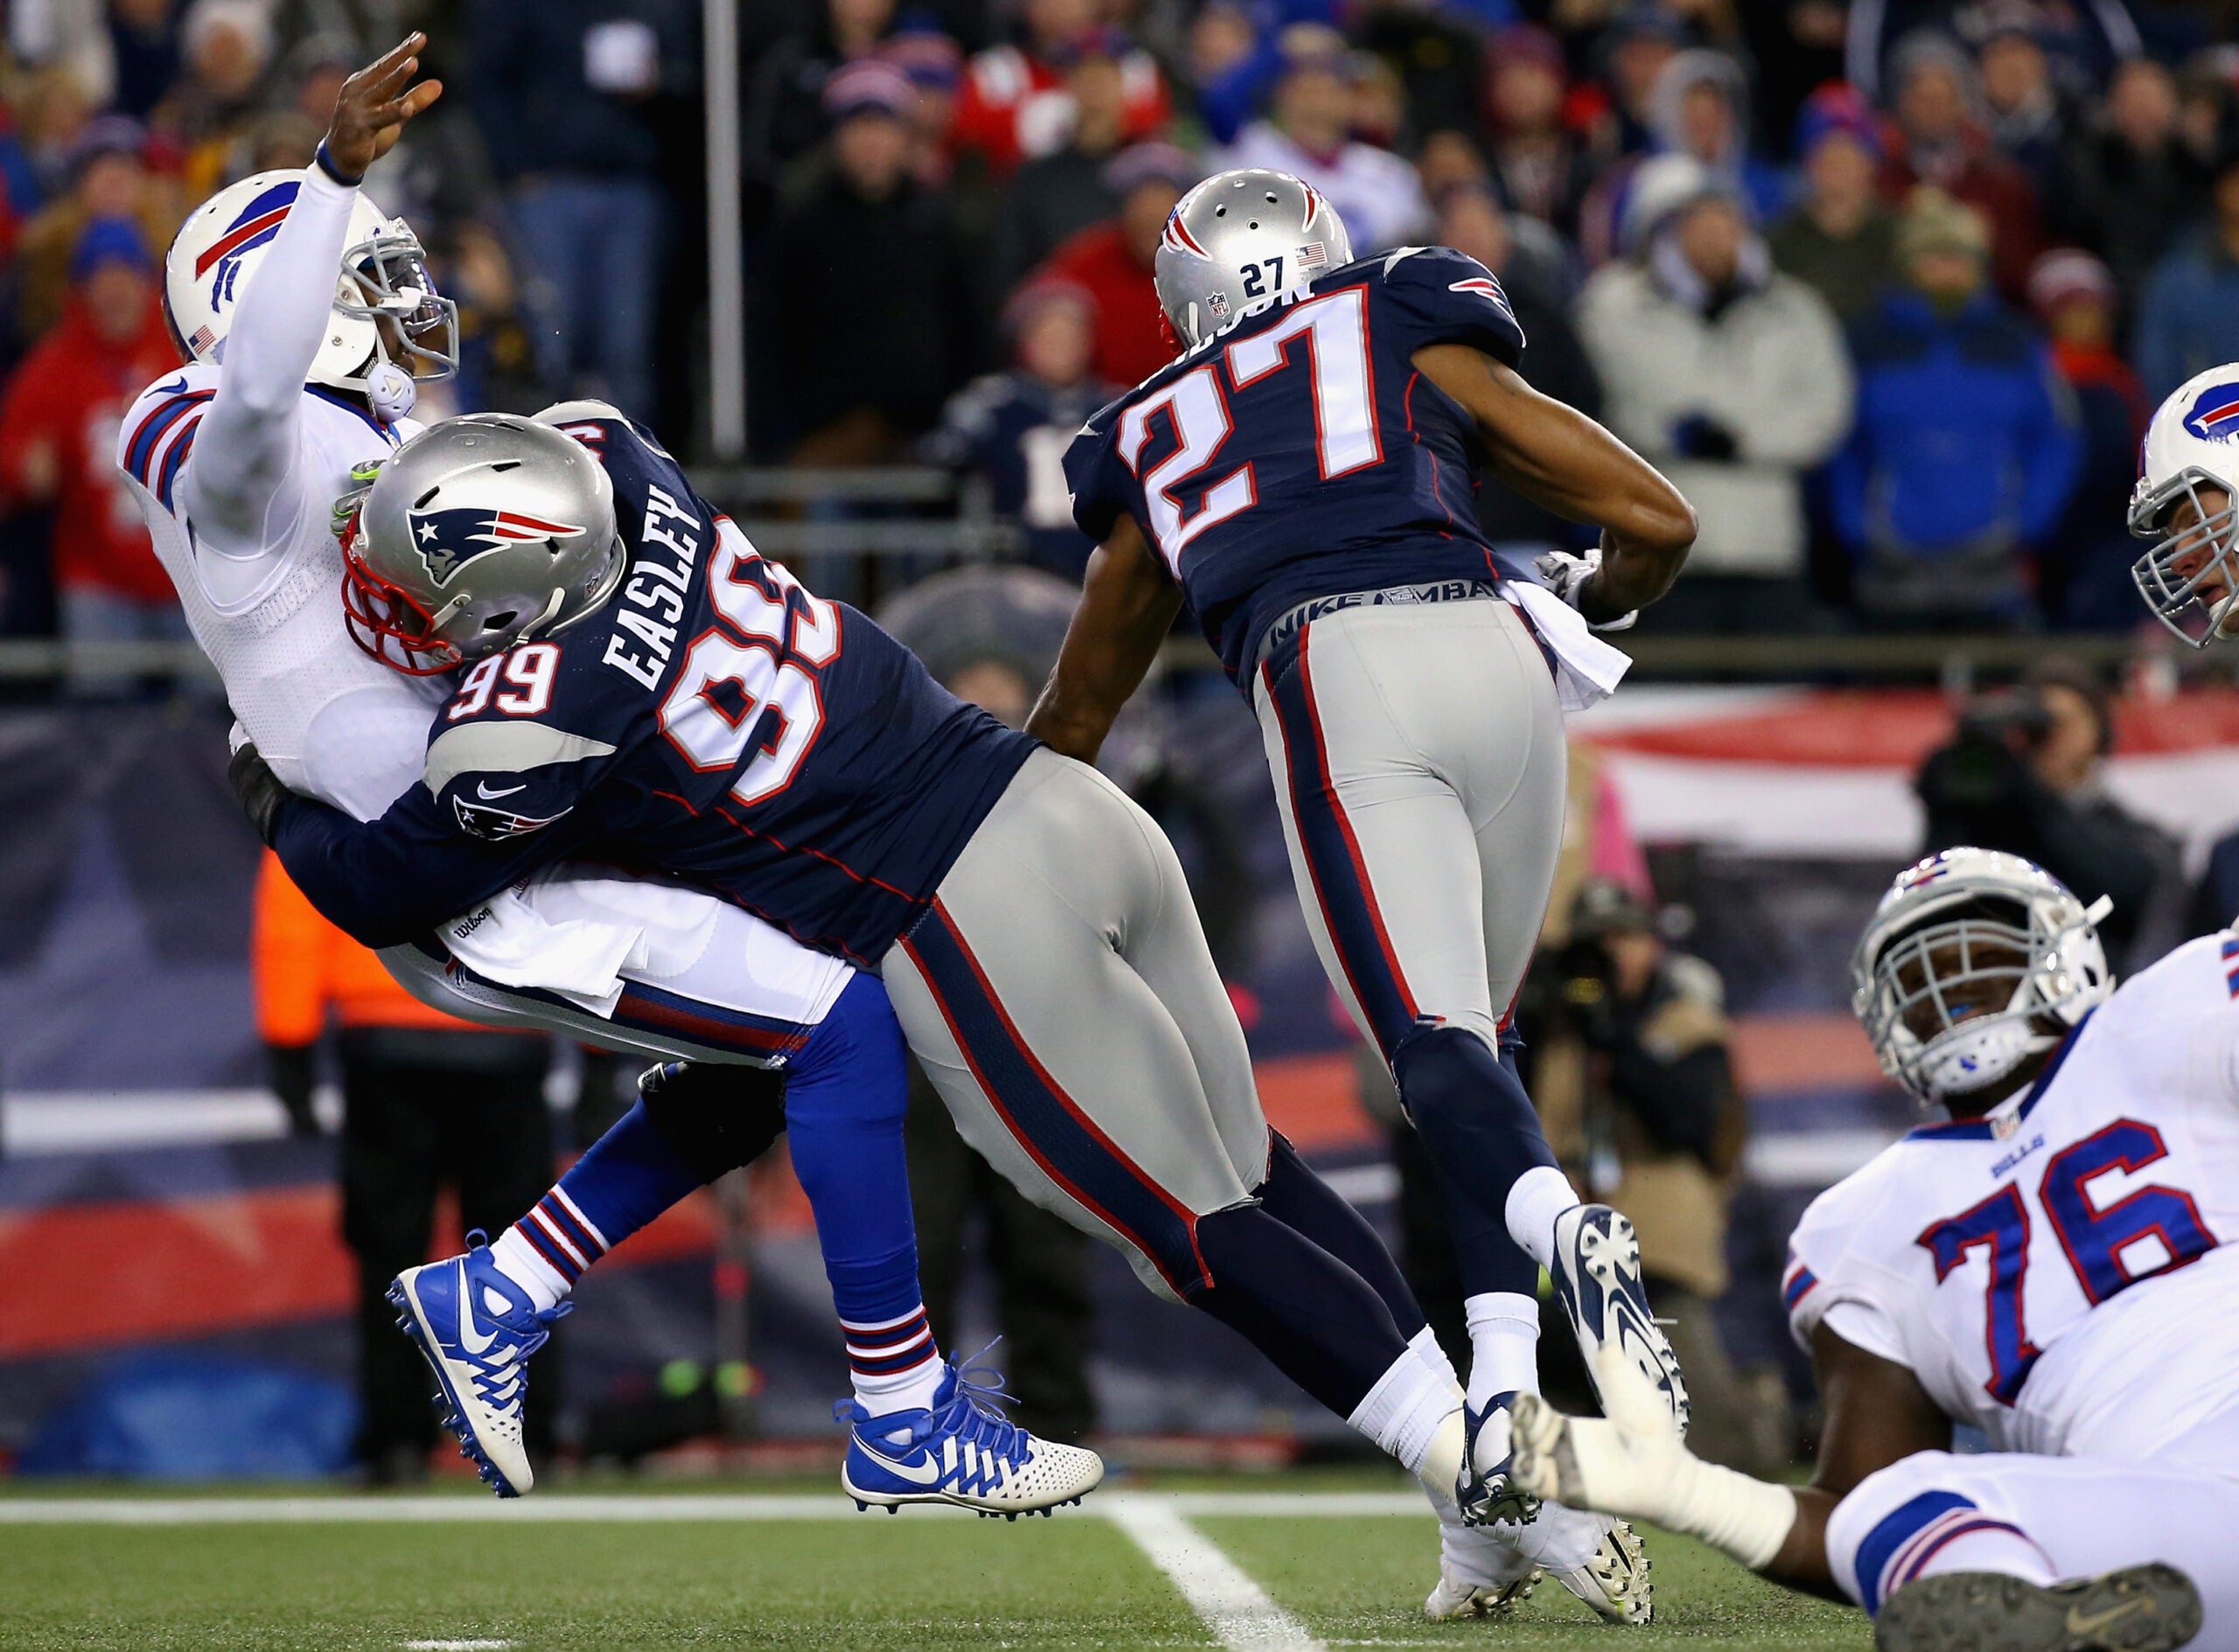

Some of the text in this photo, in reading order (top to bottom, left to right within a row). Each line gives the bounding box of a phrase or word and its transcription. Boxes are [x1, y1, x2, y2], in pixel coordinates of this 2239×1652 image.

[1240, 256, 1284, 298] 27
[1118, 282, 1384, 582] 27
[601, 484, 703, 692] EASLEY
[1270, 594, 1364, 649] NIKE
[447, 641, 561, 721] 99
[658, 514, 841, 807] 99
[453, 906, 492, 939] Wilson
[1915, 1118, 2219, 1409] 76
